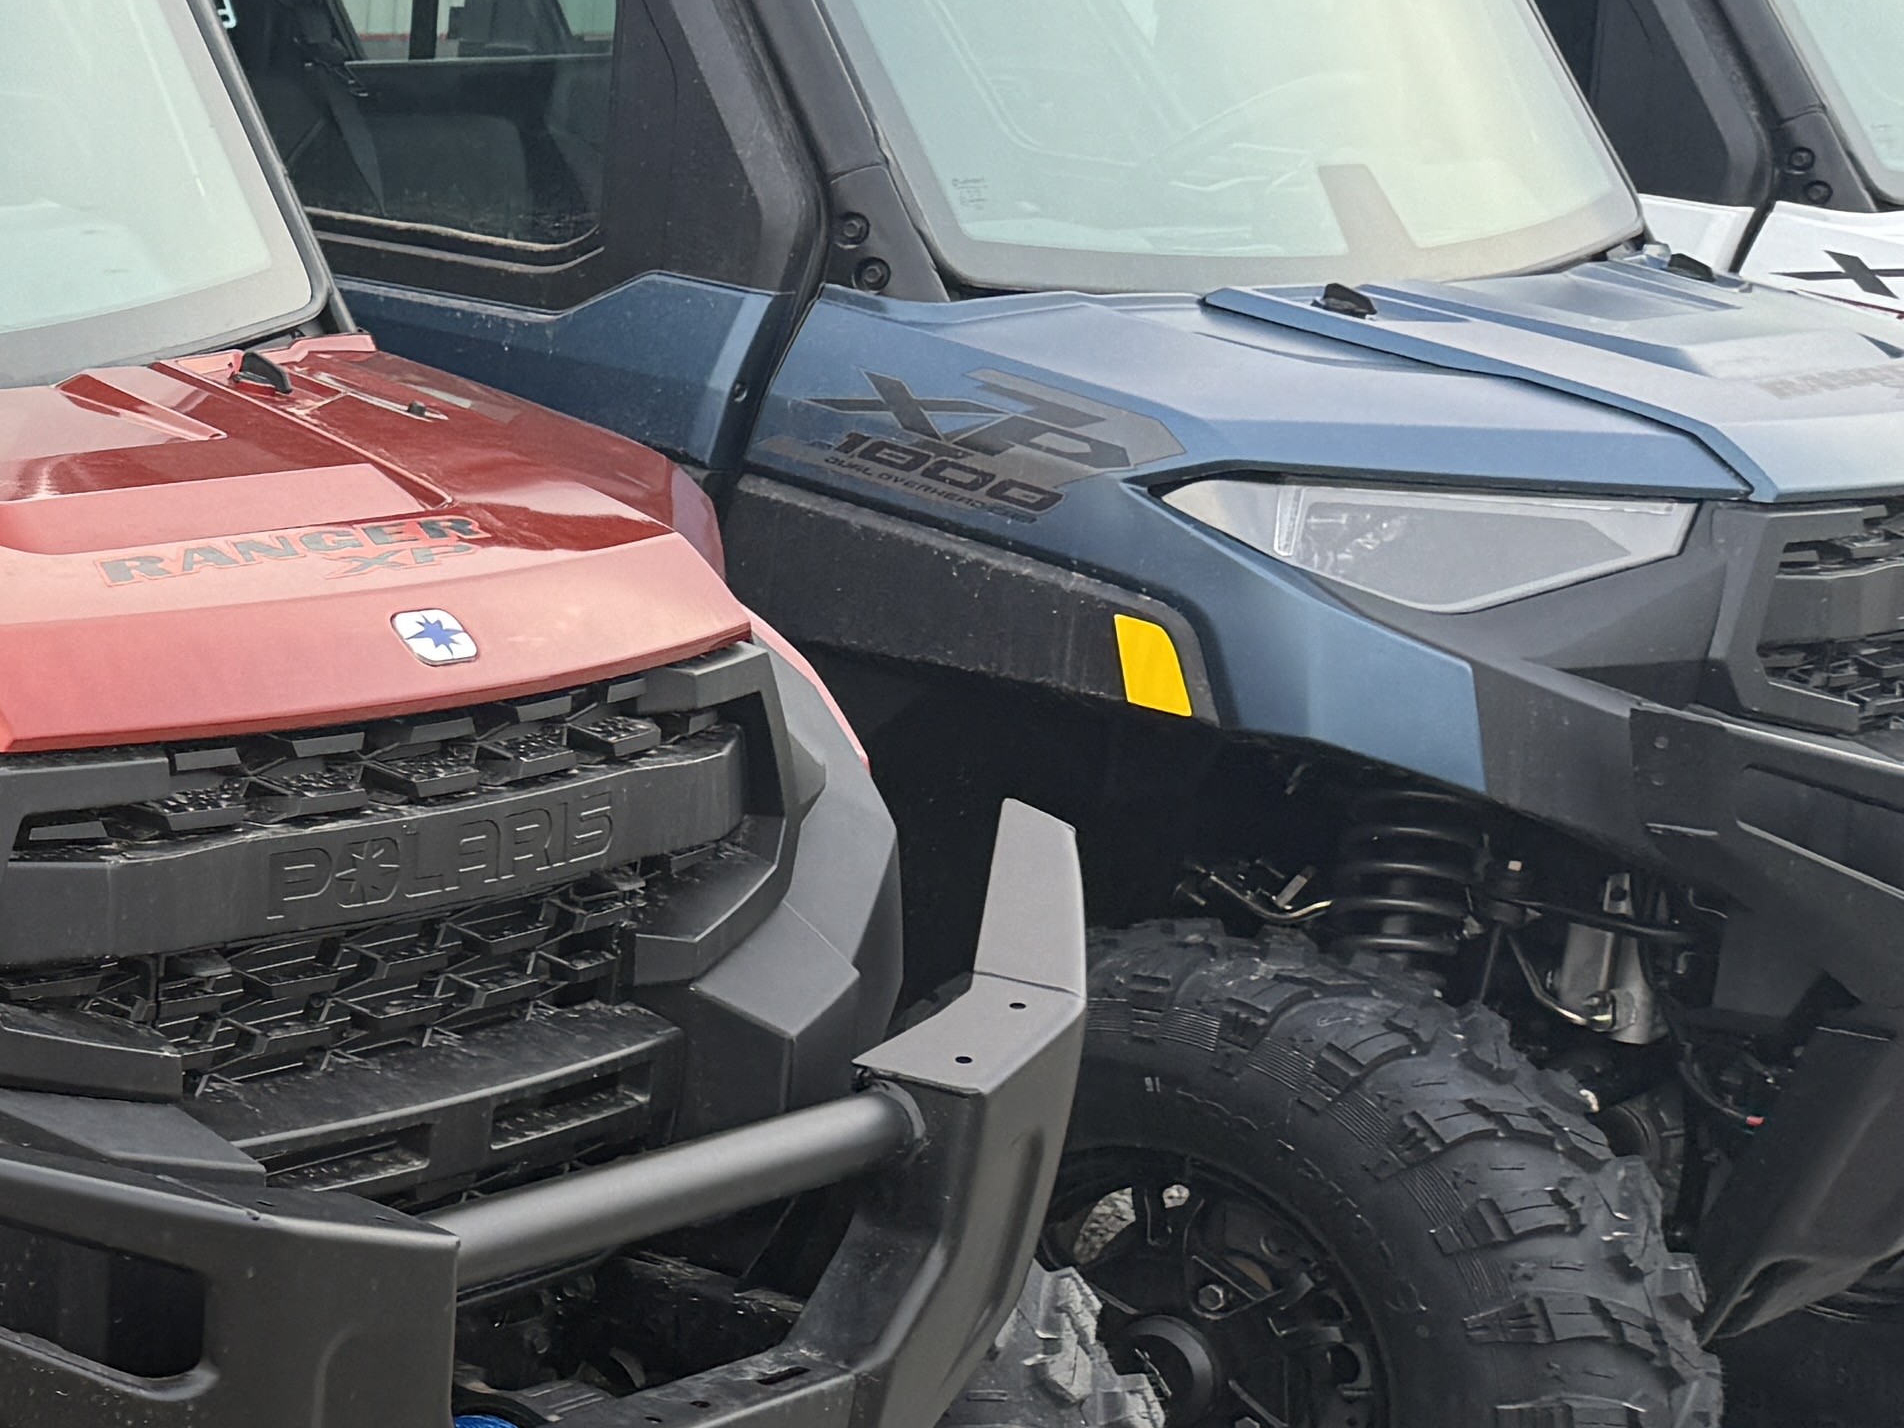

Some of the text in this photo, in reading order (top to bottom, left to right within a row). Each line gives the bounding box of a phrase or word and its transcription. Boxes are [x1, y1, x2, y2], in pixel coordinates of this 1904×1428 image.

[808, 369, 1132, 469] XP
[824, 455, 873, 476] DUAL
[878, 473, 985, 509] OVERHEAD
[834, 431, 1067, 514] 1000
[96, 514, 493, 587] RANGER
[324, 541, 484, 580] XP
[264, 788, 616, 921] POLARIS
